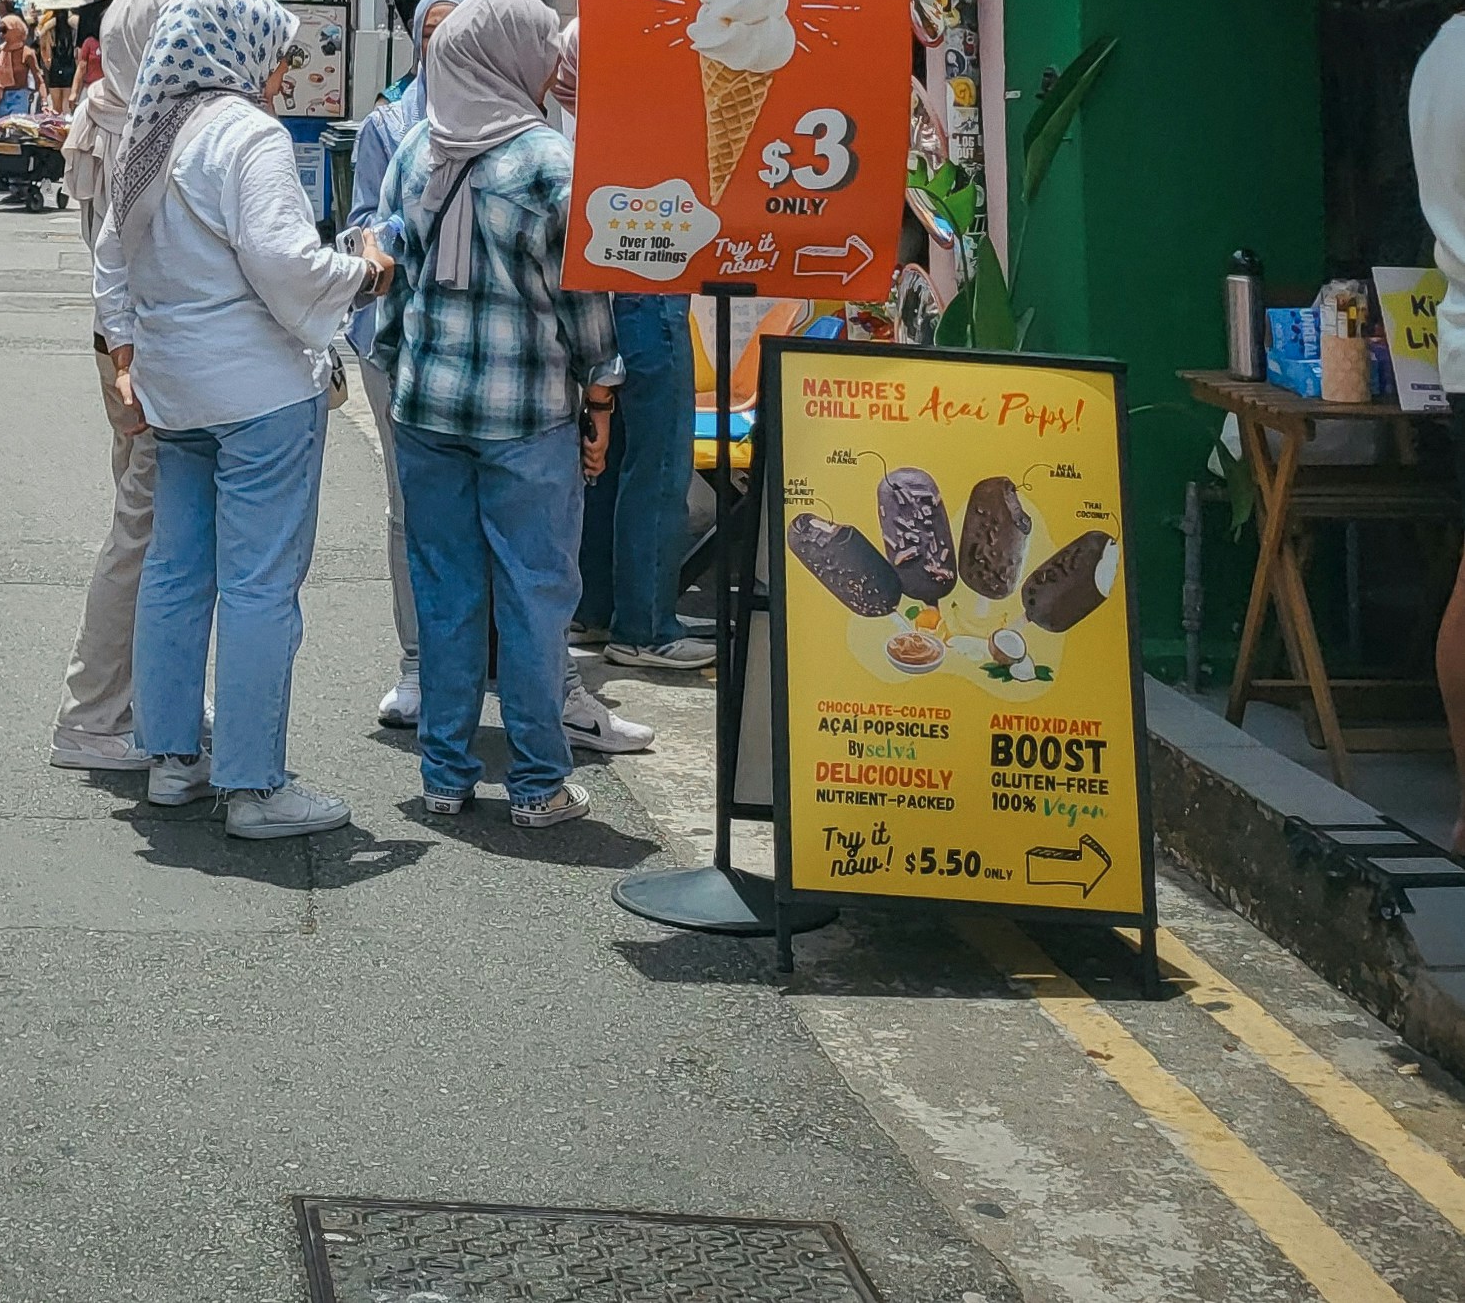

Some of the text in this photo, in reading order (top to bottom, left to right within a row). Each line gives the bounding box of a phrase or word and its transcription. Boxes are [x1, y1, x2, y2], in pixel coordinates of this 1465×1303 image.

[609, 193, 694, 218] Google
[765, 197, 828, 215] ONLY
[620, 235, 675, 248] Over 100+
[714, 233, 776, 262] Try it
[604, 249, 687, 263] 5-star ratings
[718, 251, 780, 276] now!
[802, 378, 906, 401] NATURE'S
[805, 400, 910, 422] CHILL PILL
[997, 393, 1085, 437] Pops!
[1076, 510, 1110, 520] COCONUT
[817, 700, 952, 720] CHOCOLATE-COATED
[863, 719, 950, 739] POPSICLES
[990, 713, 1102, 738] ANTIOXIDANT
[848, 740, 865, 758] By
[990, 733, 1108, 774] BOOST
[815, 761, 953, 791] DELICIOUSLY
[991, 772, 1110, 795] GLUTEN-FREE
[815, 788, 955, 812] NUTRIENT-PACKED
[991, 791, 1109, 828] 100% Vegan
[821, 820, 892, 858] Try it
[829, 845, 894, 878] now!
[904, 846, 1014, 881] $5.50 ONLY
